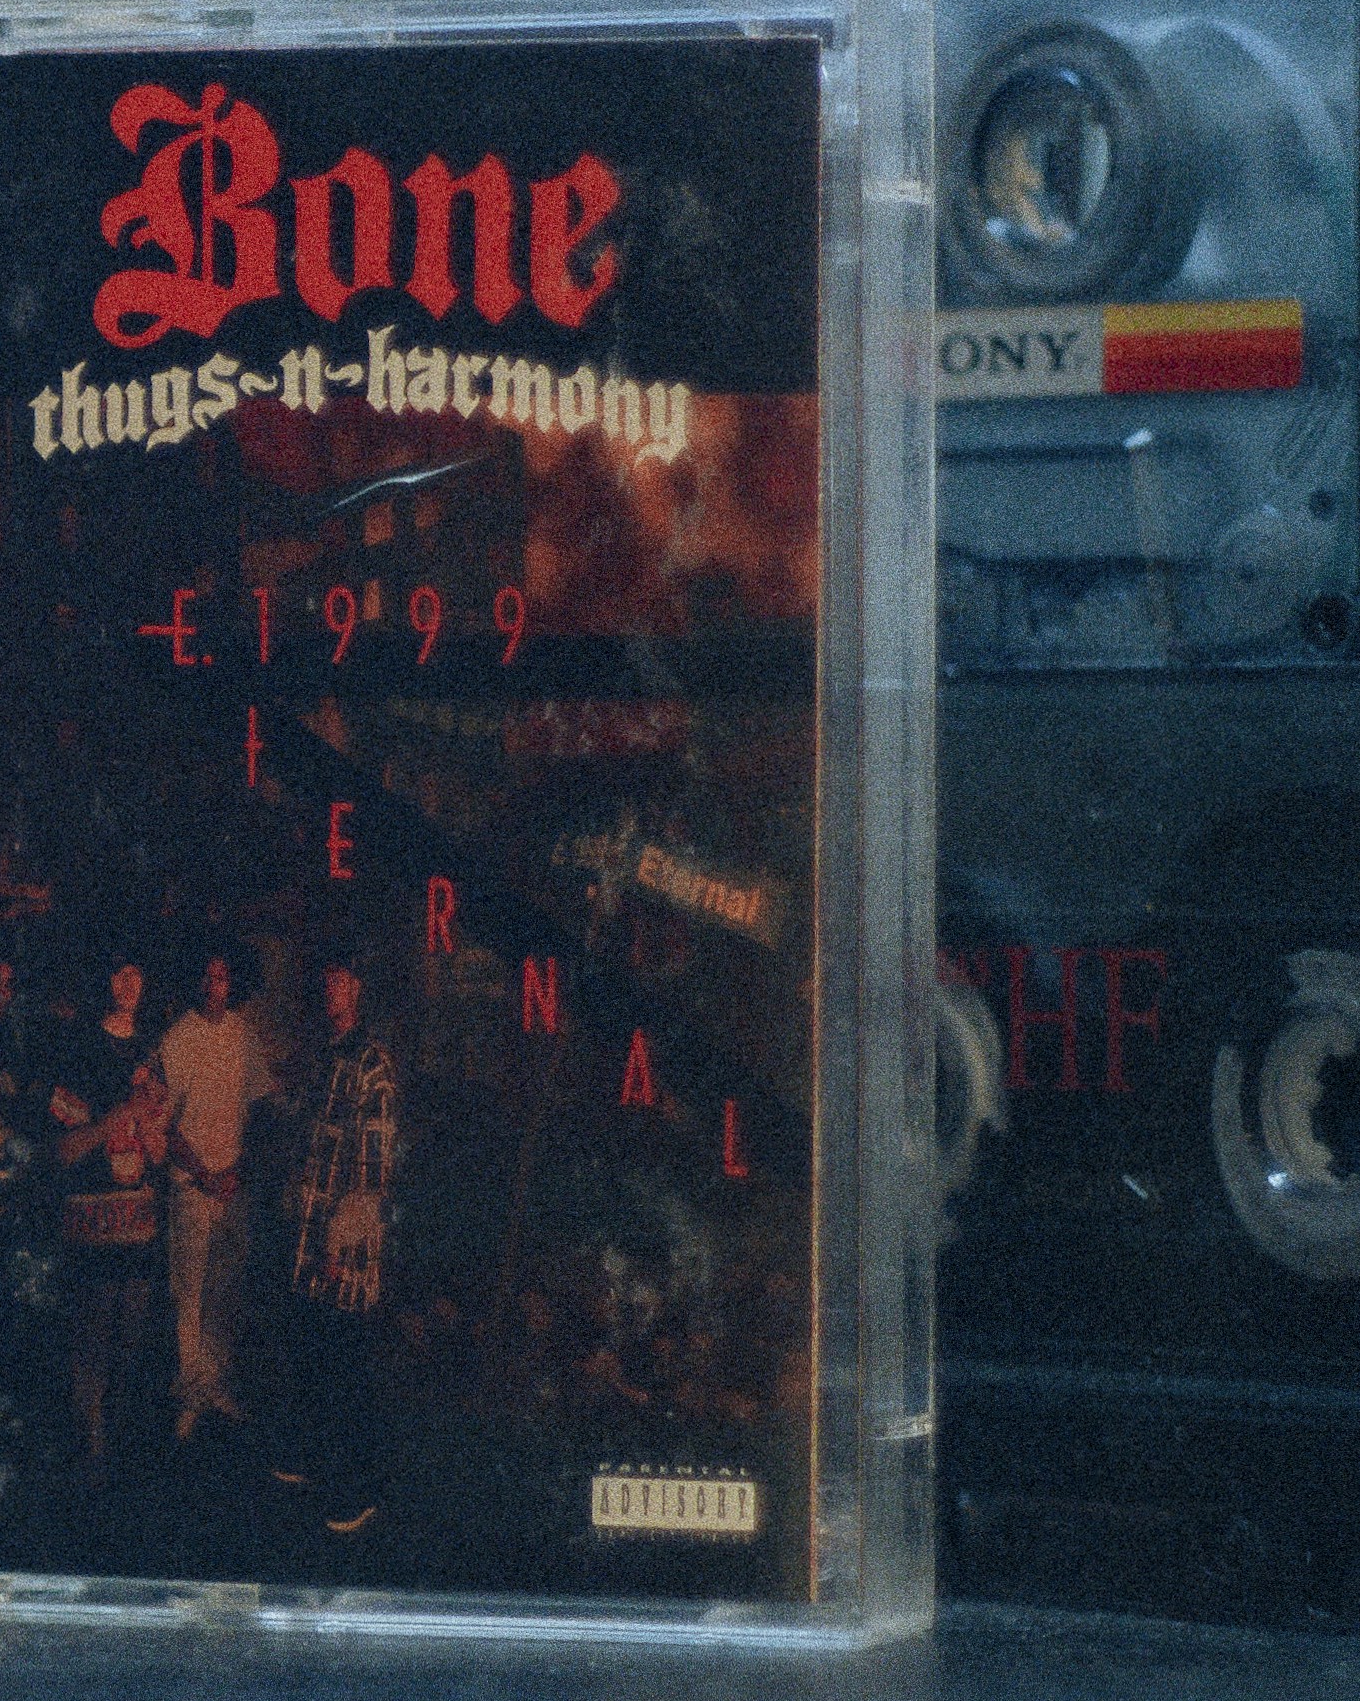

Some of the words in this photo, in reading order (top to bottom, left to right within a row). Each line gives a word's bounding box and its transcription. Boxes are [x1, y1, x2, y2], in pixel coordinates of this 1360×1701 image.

[92, 83, 622, 349] Bone
[939, 328, 1079, 376] ONY
[1006, 945, 1169, 1093] HF
